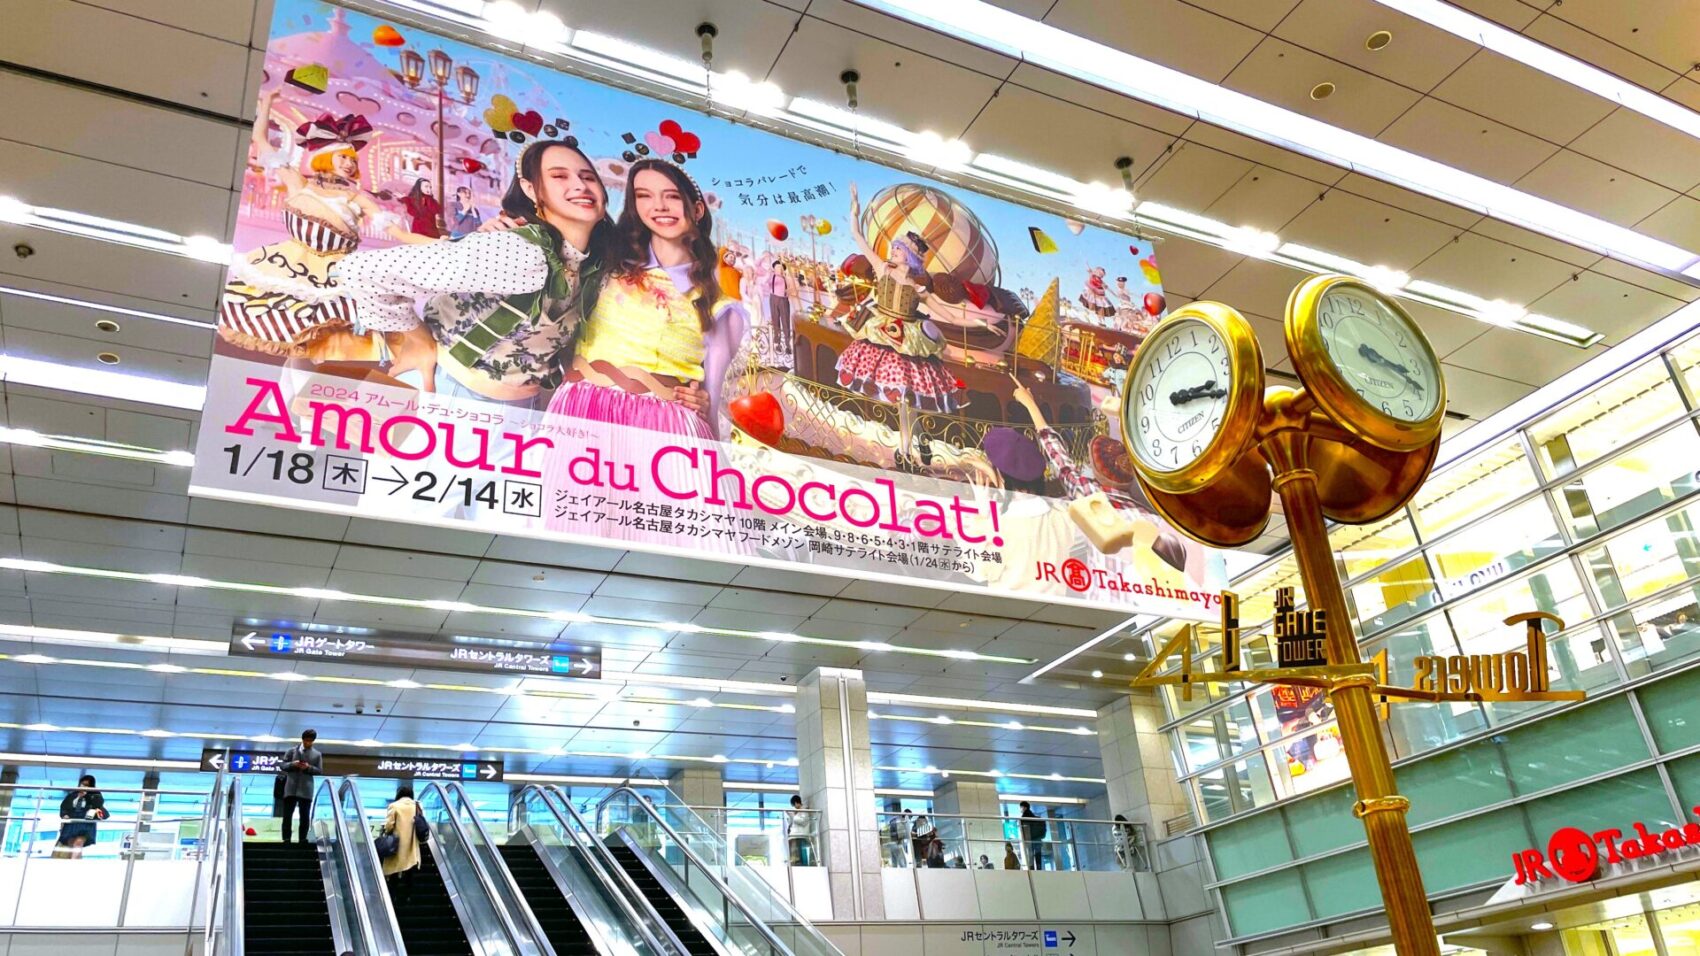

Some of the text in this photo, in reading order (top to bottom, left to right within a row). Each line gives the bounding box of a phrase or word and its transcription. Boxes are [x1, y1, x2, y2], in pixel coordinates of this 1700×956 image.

[711, 165, 807, 188] ショコラパレードで
[738, 181, 837, 206] 気分は最高潮!
[1166, 336, 1181, 359] 12
[1190, 330, 1198, 347] 1
[1208, 334, 1219, 354] 2
[1150, 358, 1163, 378] 11
[1221, 357, 1230, 376] 3
[311, 384, 359, 402] 2024
[366, 392, 504, 425] アムール・デュ・ショコラ
[1141, 384, 1154, 407] 10
[1402, 399, 1414, 417] 5
[1141, 416, 1150, 434] 9
[1178, 411, 1205, 434] CITIZEN
[1152, 439, 1162, 457] 8
[1170, 446, 1178, 464] 7
[225, 377, 1004, 547] Amour du Chocolat!
[224, 444, 315, 485] 1/18
[412, 471, 499, 510] 2/14
[1035, 561, 1061, 583] JR
[1274, 587, 1295, 608] JR
[1273, 608, 1327, 637] GATE
[294, 635, 375, 651] JRゲートタワー
[450, 648, 550, 665] JRセントラルタワーズ
[377, 760, 461, 773] JRセントラルタワーズ
[1512, 848, 1552, 885] JR
[1593, 805, 1700, 864] Takas
[961, 930, 1039, 942] JRセントラルタワーズ
